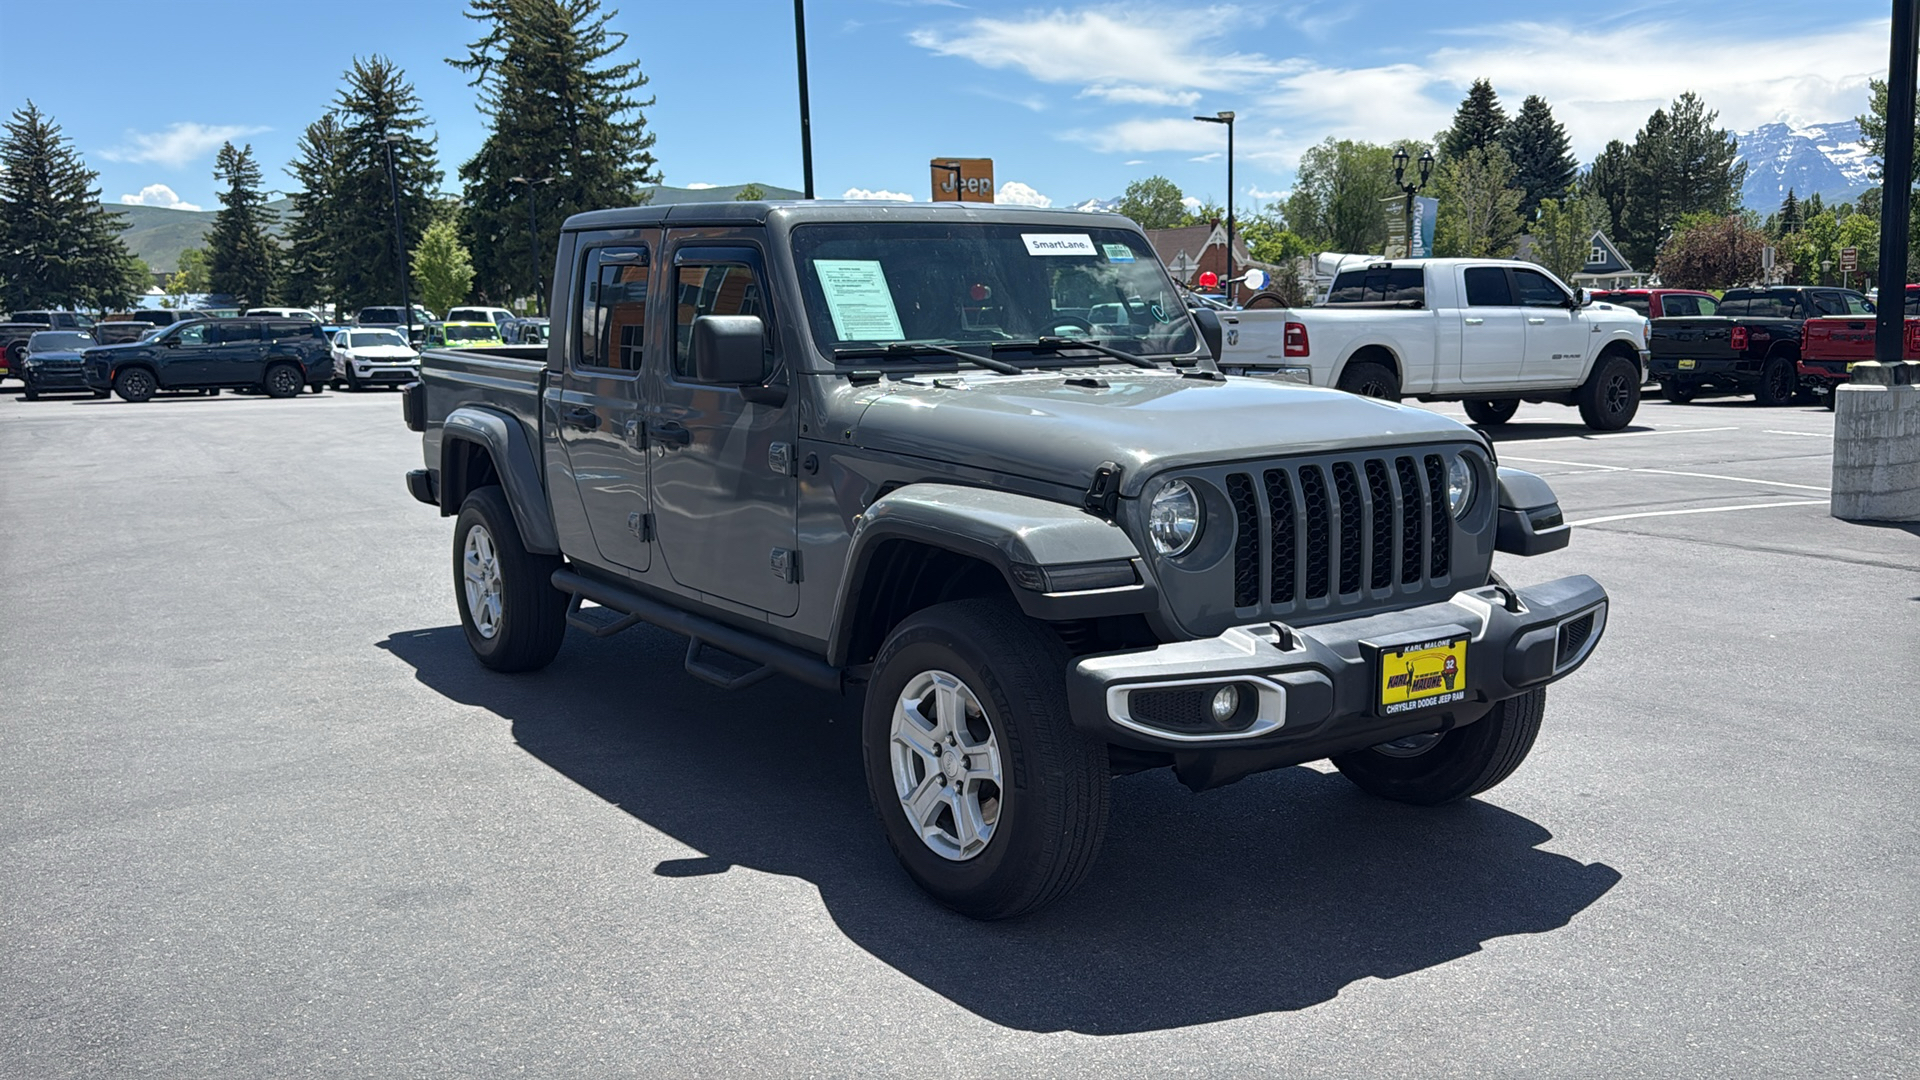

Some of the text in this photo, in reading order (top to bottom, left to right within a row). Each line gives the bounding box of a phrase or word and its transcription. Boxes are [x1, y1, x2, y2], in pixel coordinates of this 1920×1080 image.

[942, 172, 991, 197] Jeep
[1405, 639, 1451, 653] KARL MALONE
[1446, 659, 1454, 669] 32
[1387, 673, 1409, 689] KARL
[1411, 675, 1442, 692] MALONE
[1386, 691, 1464, 714] CHRYSLER DODGE JEEP RAM
